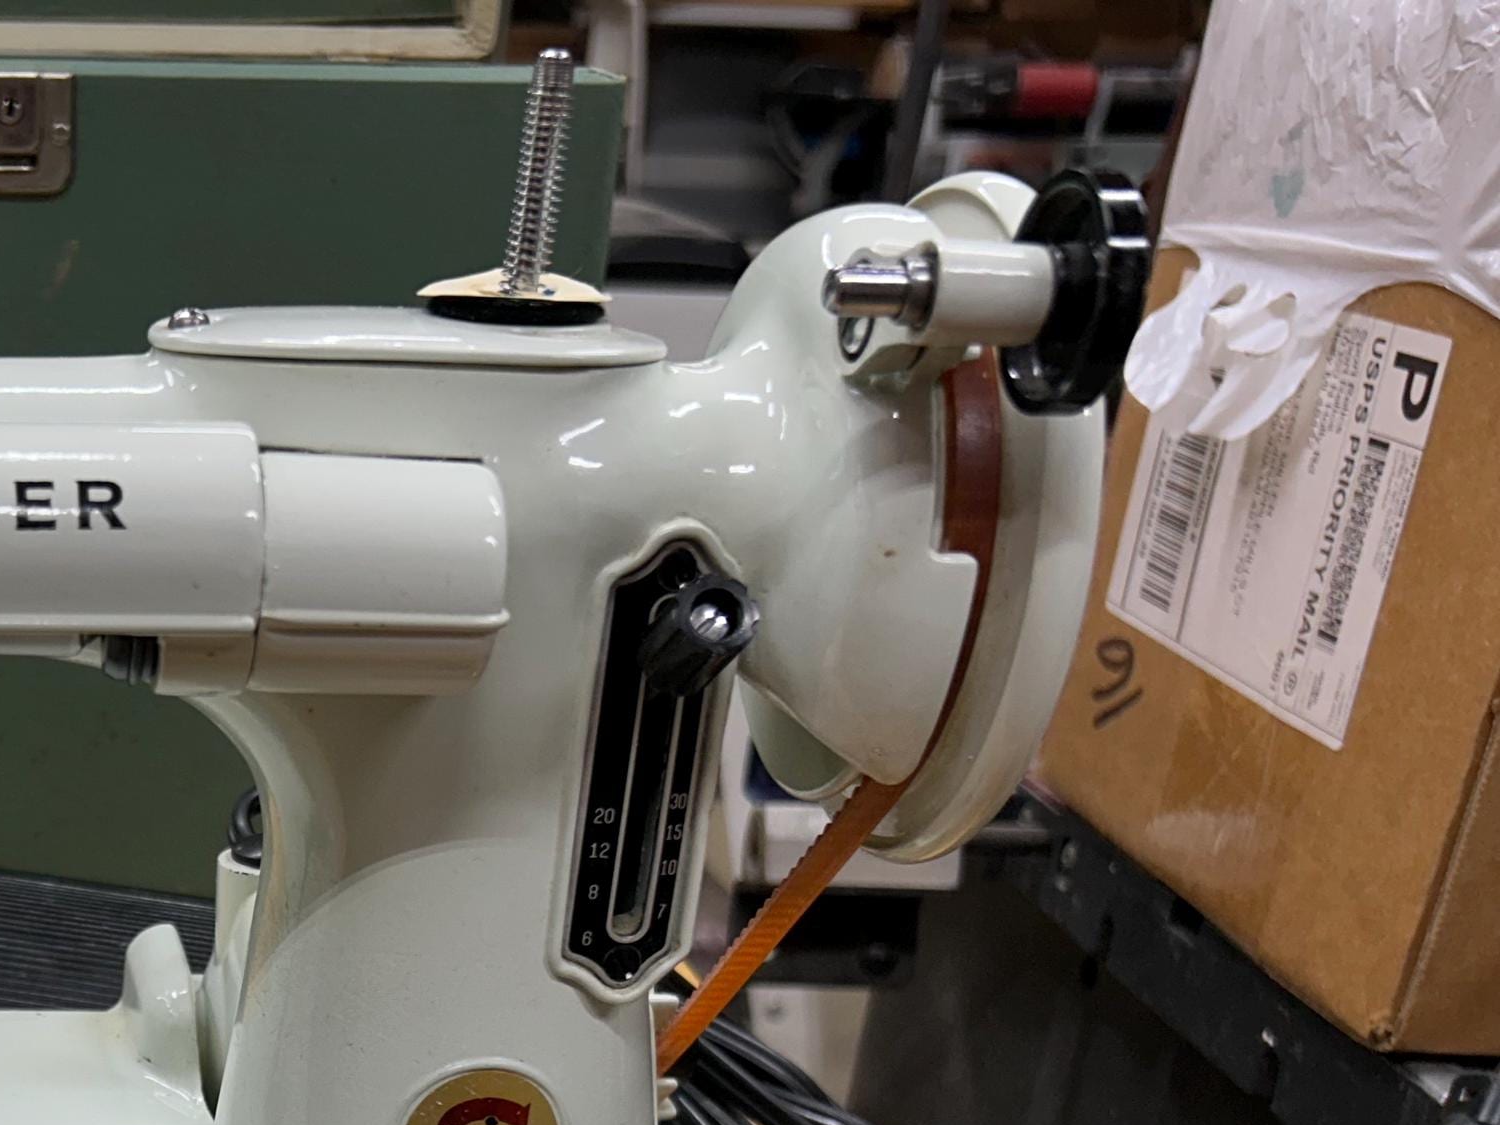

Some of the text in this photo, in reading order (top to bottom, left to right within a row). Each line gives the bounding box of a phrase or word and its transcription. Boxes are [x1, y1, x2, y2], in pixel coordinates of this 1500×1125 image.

[1354, 337, 1386, 424] USPS
[1393, 351, 1439, 421] P
[1315, 435, 1360, 582] PRIORITY
[1291, 590, 1319, 660] MAIL
[670, 793, 687, 810] 30
[593, 808, 615, 824] 20
[666, 824, 682, 841] 15
[589, 842, 610, 859] 12
[660, 859, 677, 876] 10
[588, 884, 599, 900] 8
[657, 903, 668, 920] 7
[581, 930, 593, 947] 6
